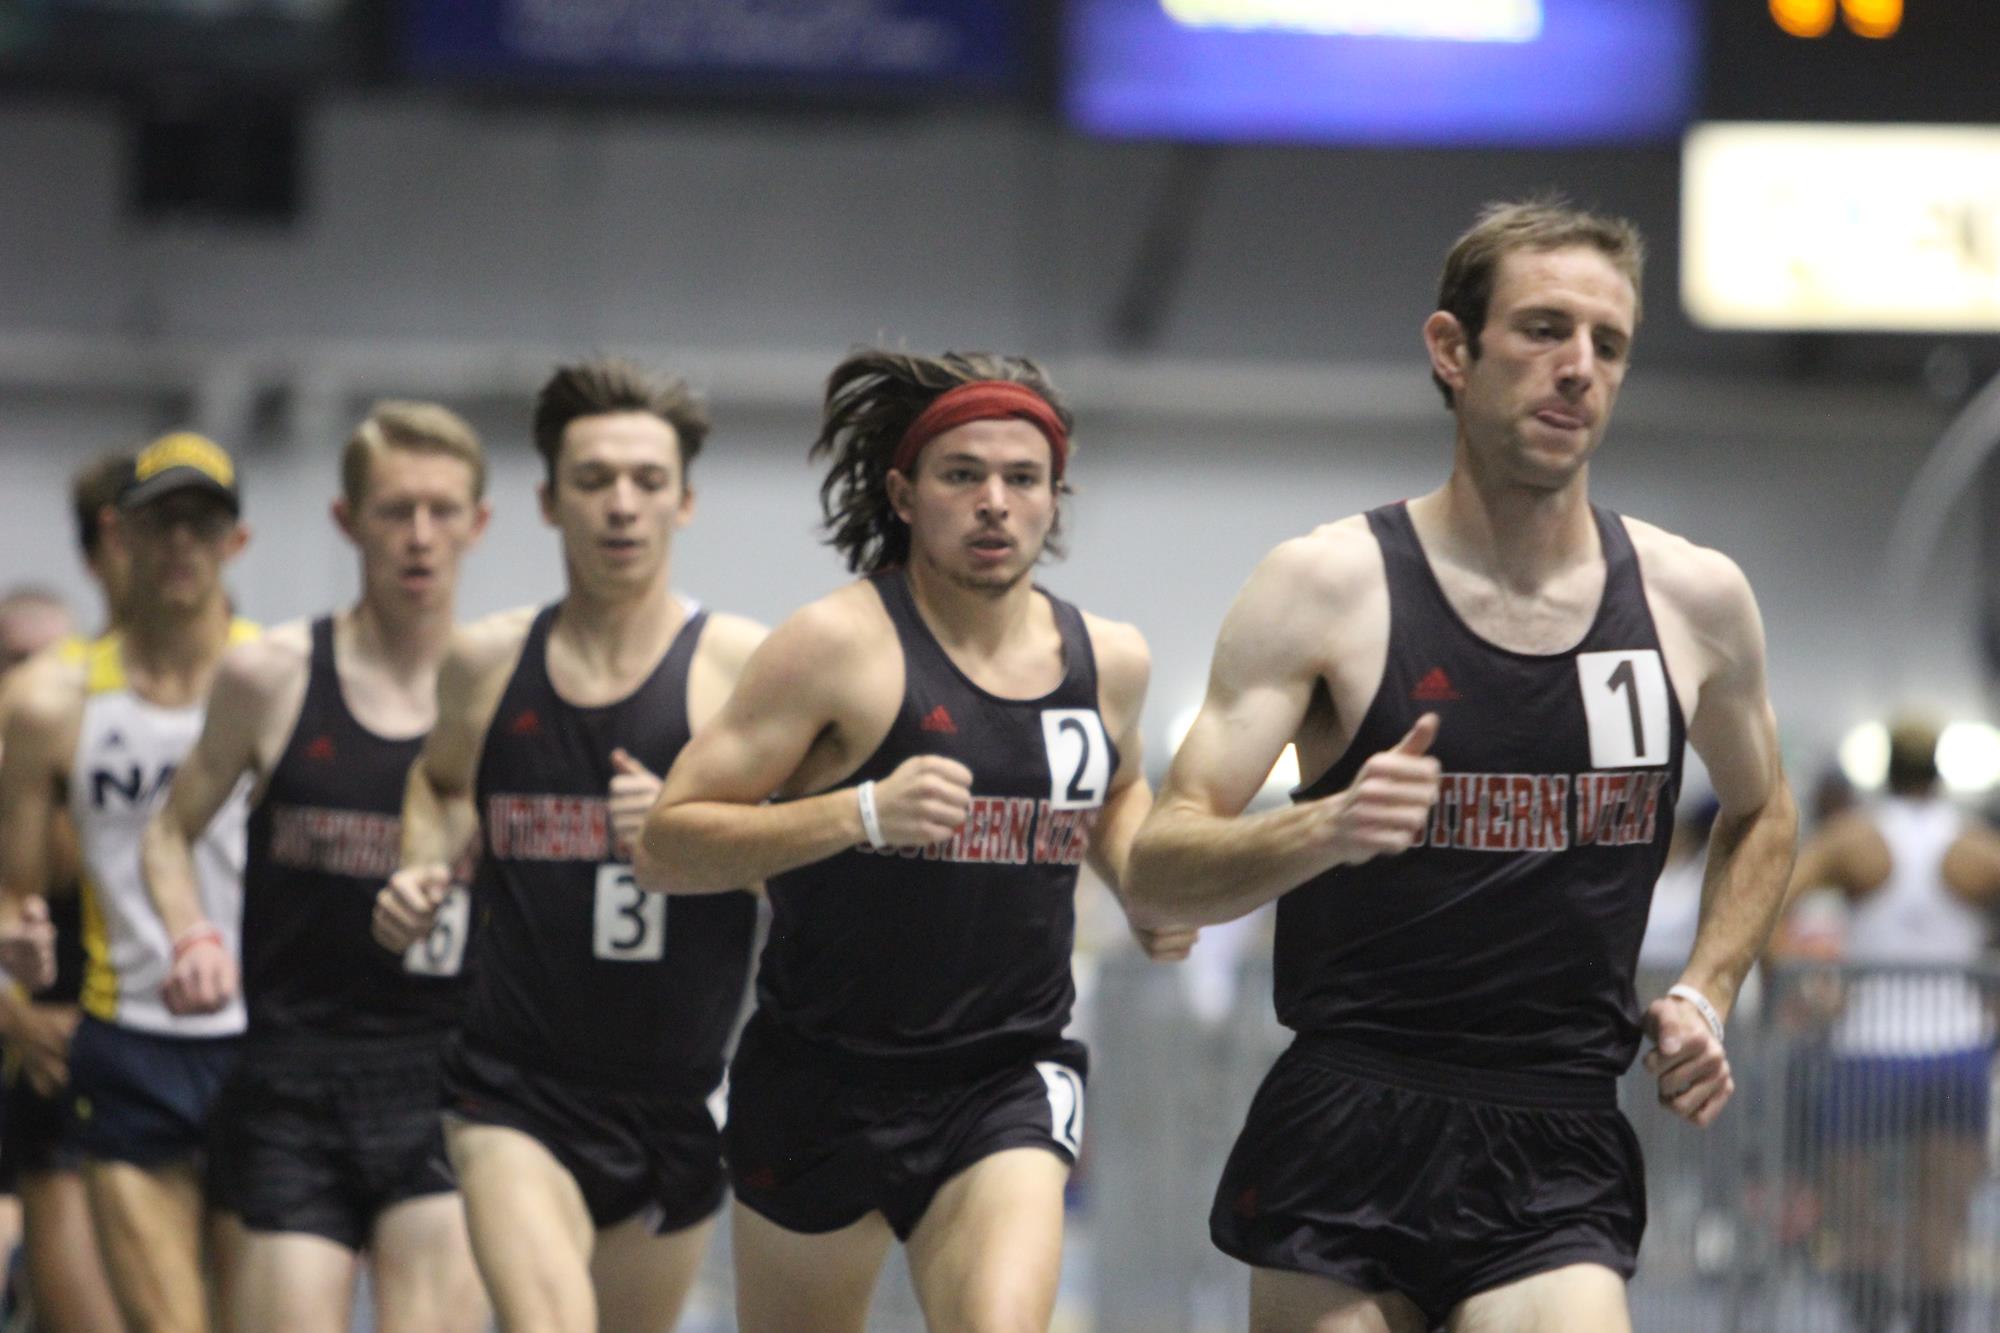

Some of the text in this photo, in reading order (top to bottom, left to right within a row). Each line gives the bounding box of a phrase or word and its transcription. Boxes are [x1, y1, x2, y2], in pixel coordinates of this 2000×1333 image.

[1605, 659, 1646, 758] 1
[1058, 717, 1095, 803] 2
[1408, 772, 1571, 852] THERN
[610, 874, 647, 950] 3
